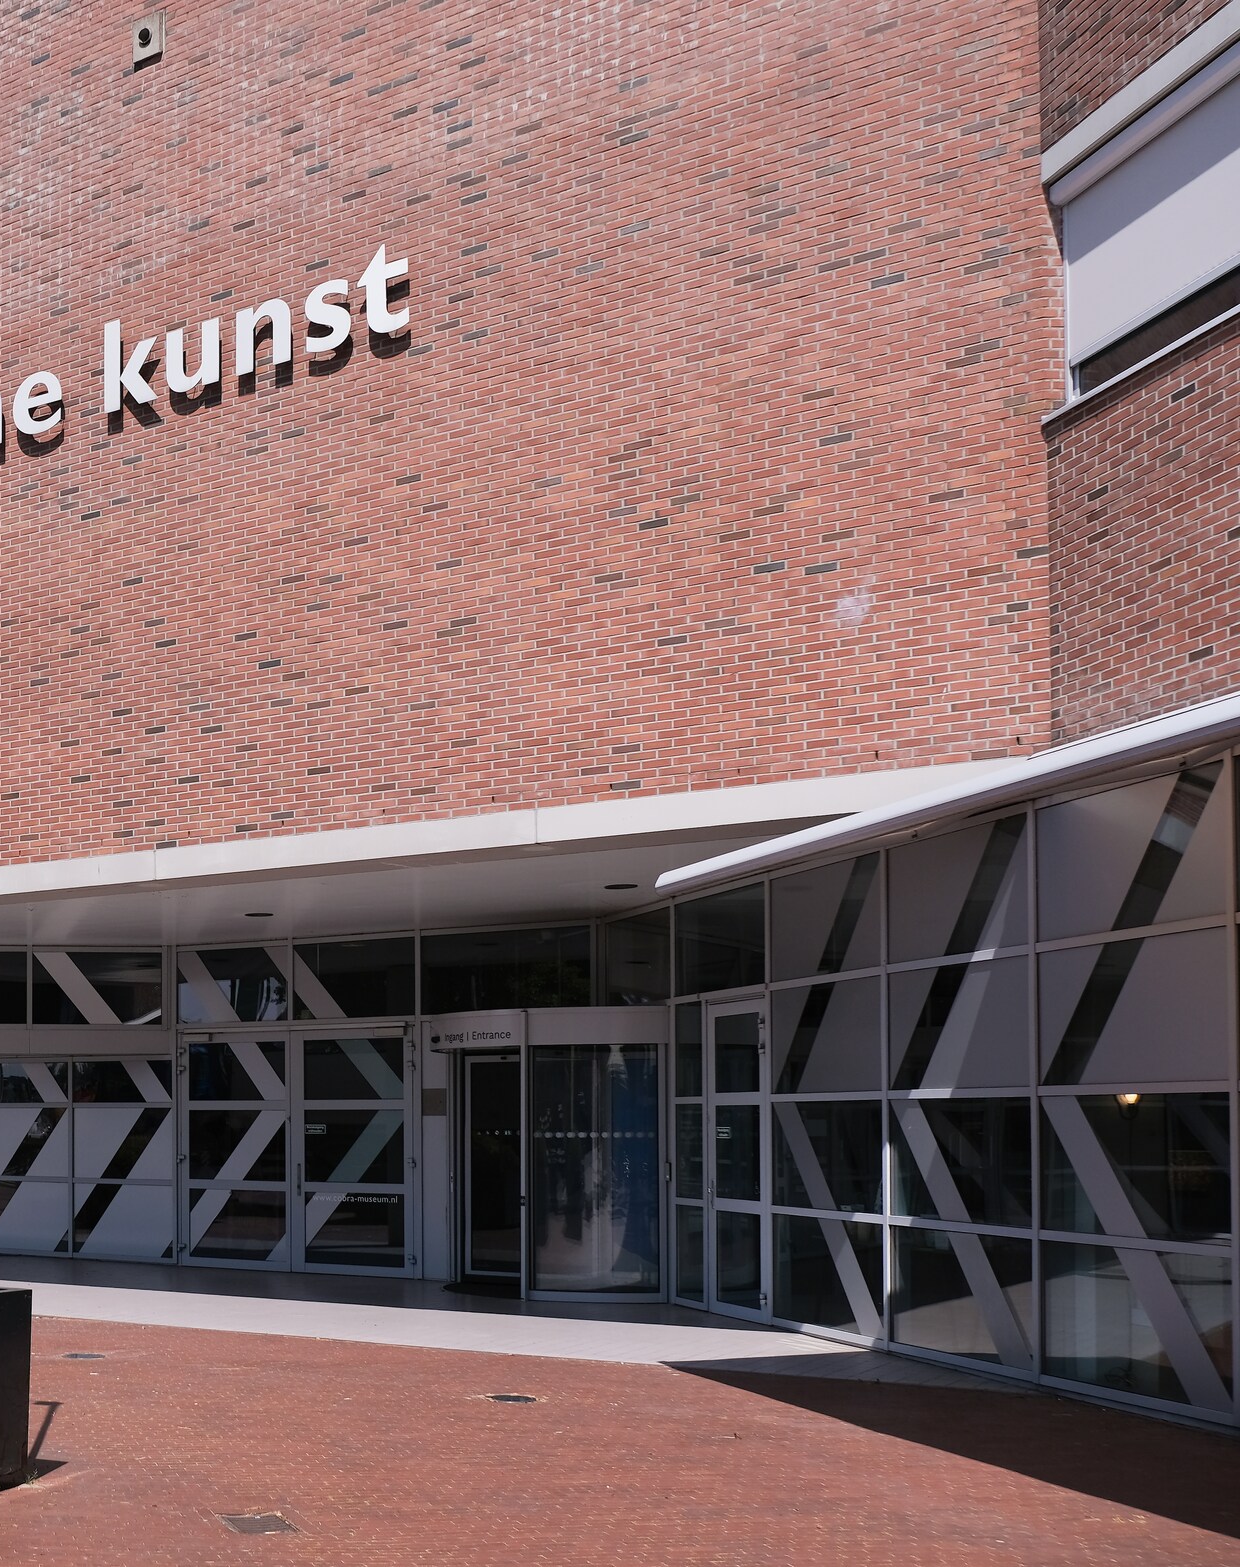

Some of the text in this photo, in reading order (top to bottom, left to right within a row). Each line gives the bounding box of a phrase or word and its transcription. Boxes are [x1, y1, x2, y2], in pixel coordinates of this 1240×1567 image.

[103, 242, 411, 415] kunst
[443, 1032, 464, 1044] Ingang
[471, 1030, 511, 1041] Entrance
[312, 1194, 398, 1204] www.cobra-museum.nl
